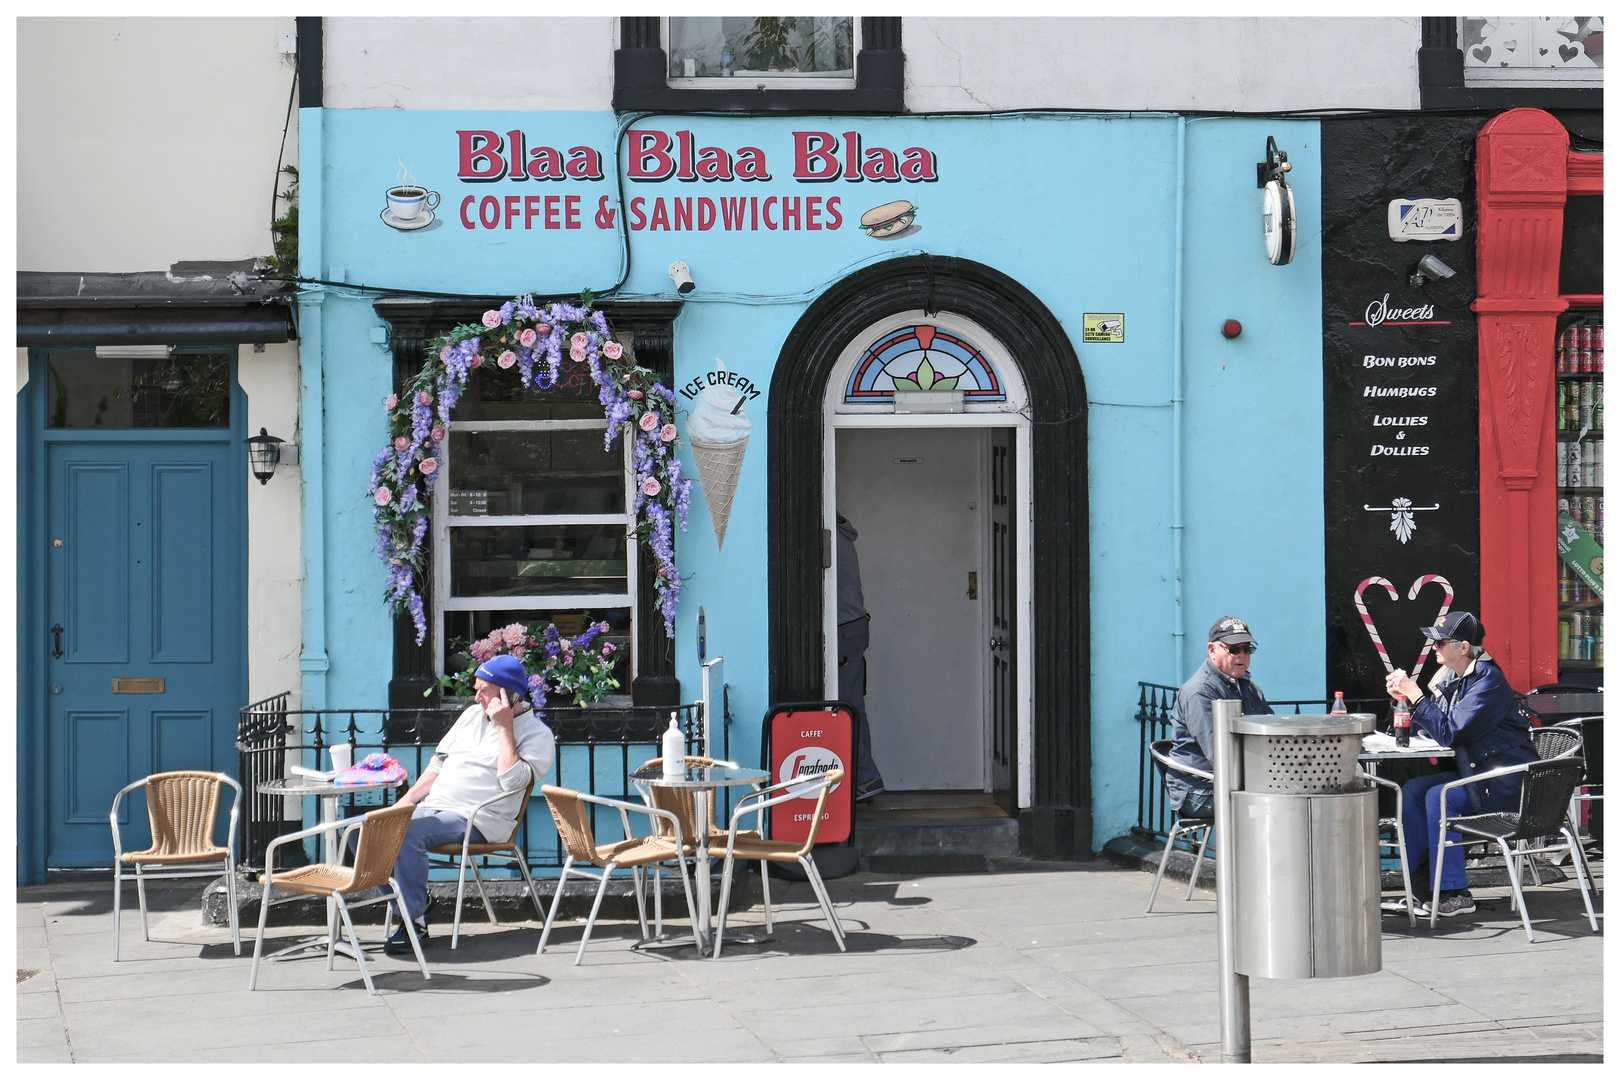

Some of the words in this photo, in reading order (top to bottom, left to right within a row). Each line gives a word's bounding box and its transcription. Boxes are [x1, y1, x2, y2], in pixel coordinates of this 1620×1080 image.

[456, 129, 605, 183] Blaa
[626, 129, 773, 183] Blaa
[791, 130, 939, 183] Blaa
[460, 195, 581, 230] COFFEE
[594, 195, 616, 230] &
[630, 196, 843, 231] SANDWICHES
[1365, 293, 1435, 327] Sweets
[678, 376, 706, 401] ICE
[706, 371, 761, 401] CREAM
[1396, 431, 1406, 440] &
[1571, 560, 1587, 576] LOTTO
[1584, 573, 1597, 587] PLUS
